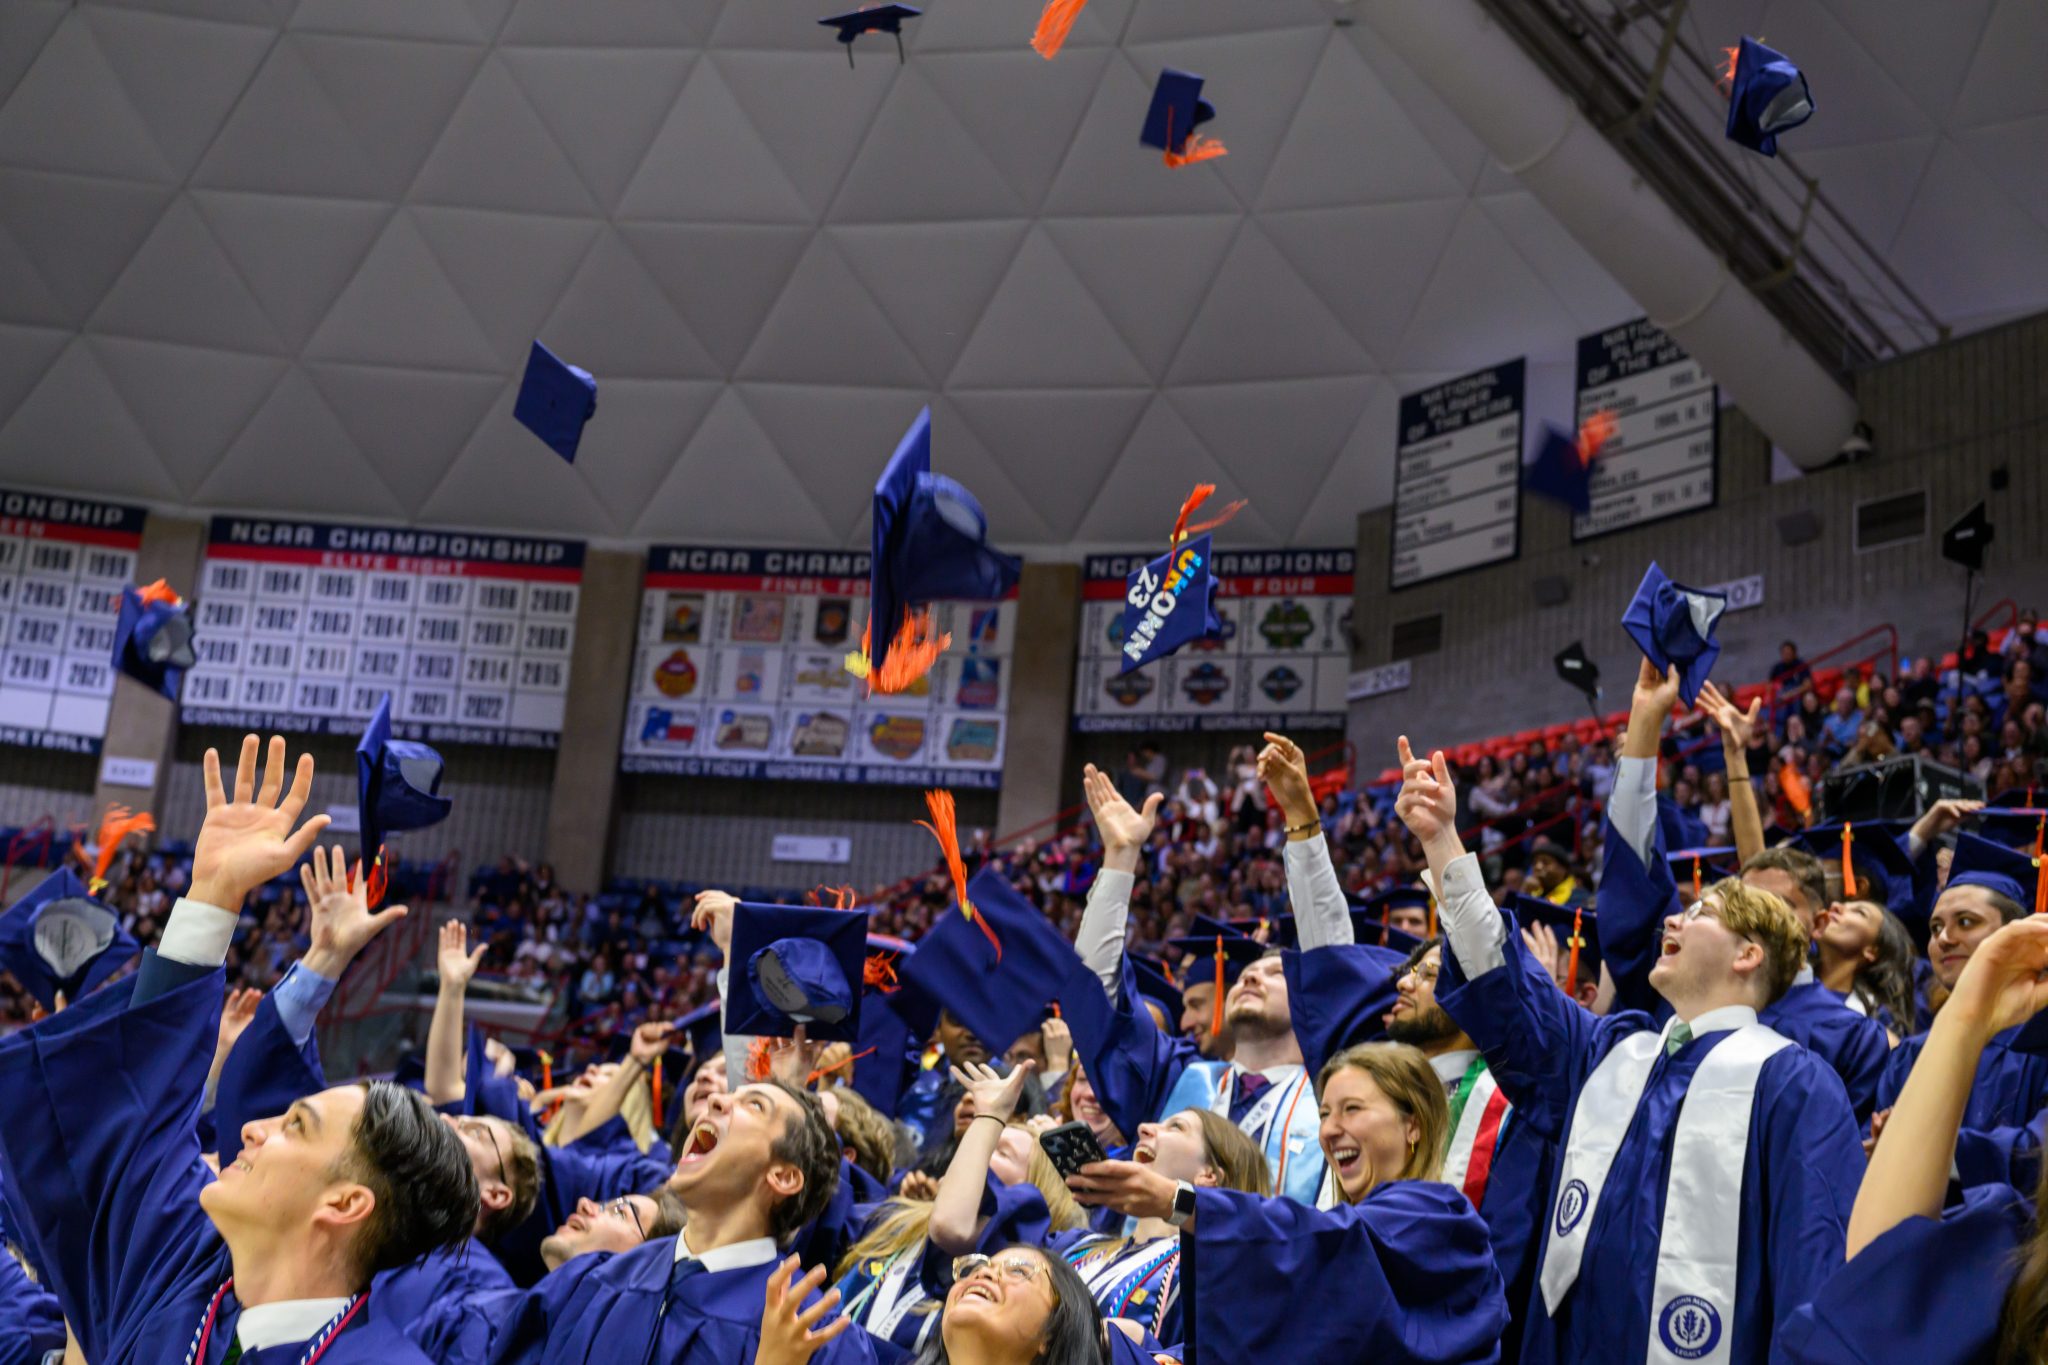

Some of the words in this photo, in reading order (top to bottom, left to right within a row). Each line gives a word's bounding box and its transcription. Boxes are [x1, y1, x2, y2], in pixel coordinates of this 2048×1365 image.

[0, 492, 124, 527] ONSHIP
[230, 521, 315, 546] NCAA
[328, 527, 565, 563] CHAMPIONSHIP
[320, 550, 387, 572] ELITE
[396, 556, 467, 577] EIGHT
[667, 550, 750, 572] NCAA
[765, 552, 871, 575] CHAMP
[761, 576, 824, 594] FINAL
[1127, 566, 1159, 609] 23
[1252, 577, 1317, 595] FOUR
[1731, 580, 1761, 605] 07
[78, 587, 110, 614] 200
[305, 647, 347, 671] 2011
[181, 707, 320, 733] CONNECTICUT
[428, 724, 561, 748] BASKETBALL
[1078, 715, 1196, 732] CONNECTICUT
[0, 728, 93, 752] KETBALL
[621, 757, 758, 779] CONNECTICUT
[765, 761, 860, 782] WOMEN'S
[866, 768, 999, 788] BASKETBALL
[1674, 1346, 1702, 1358] LEGACY
